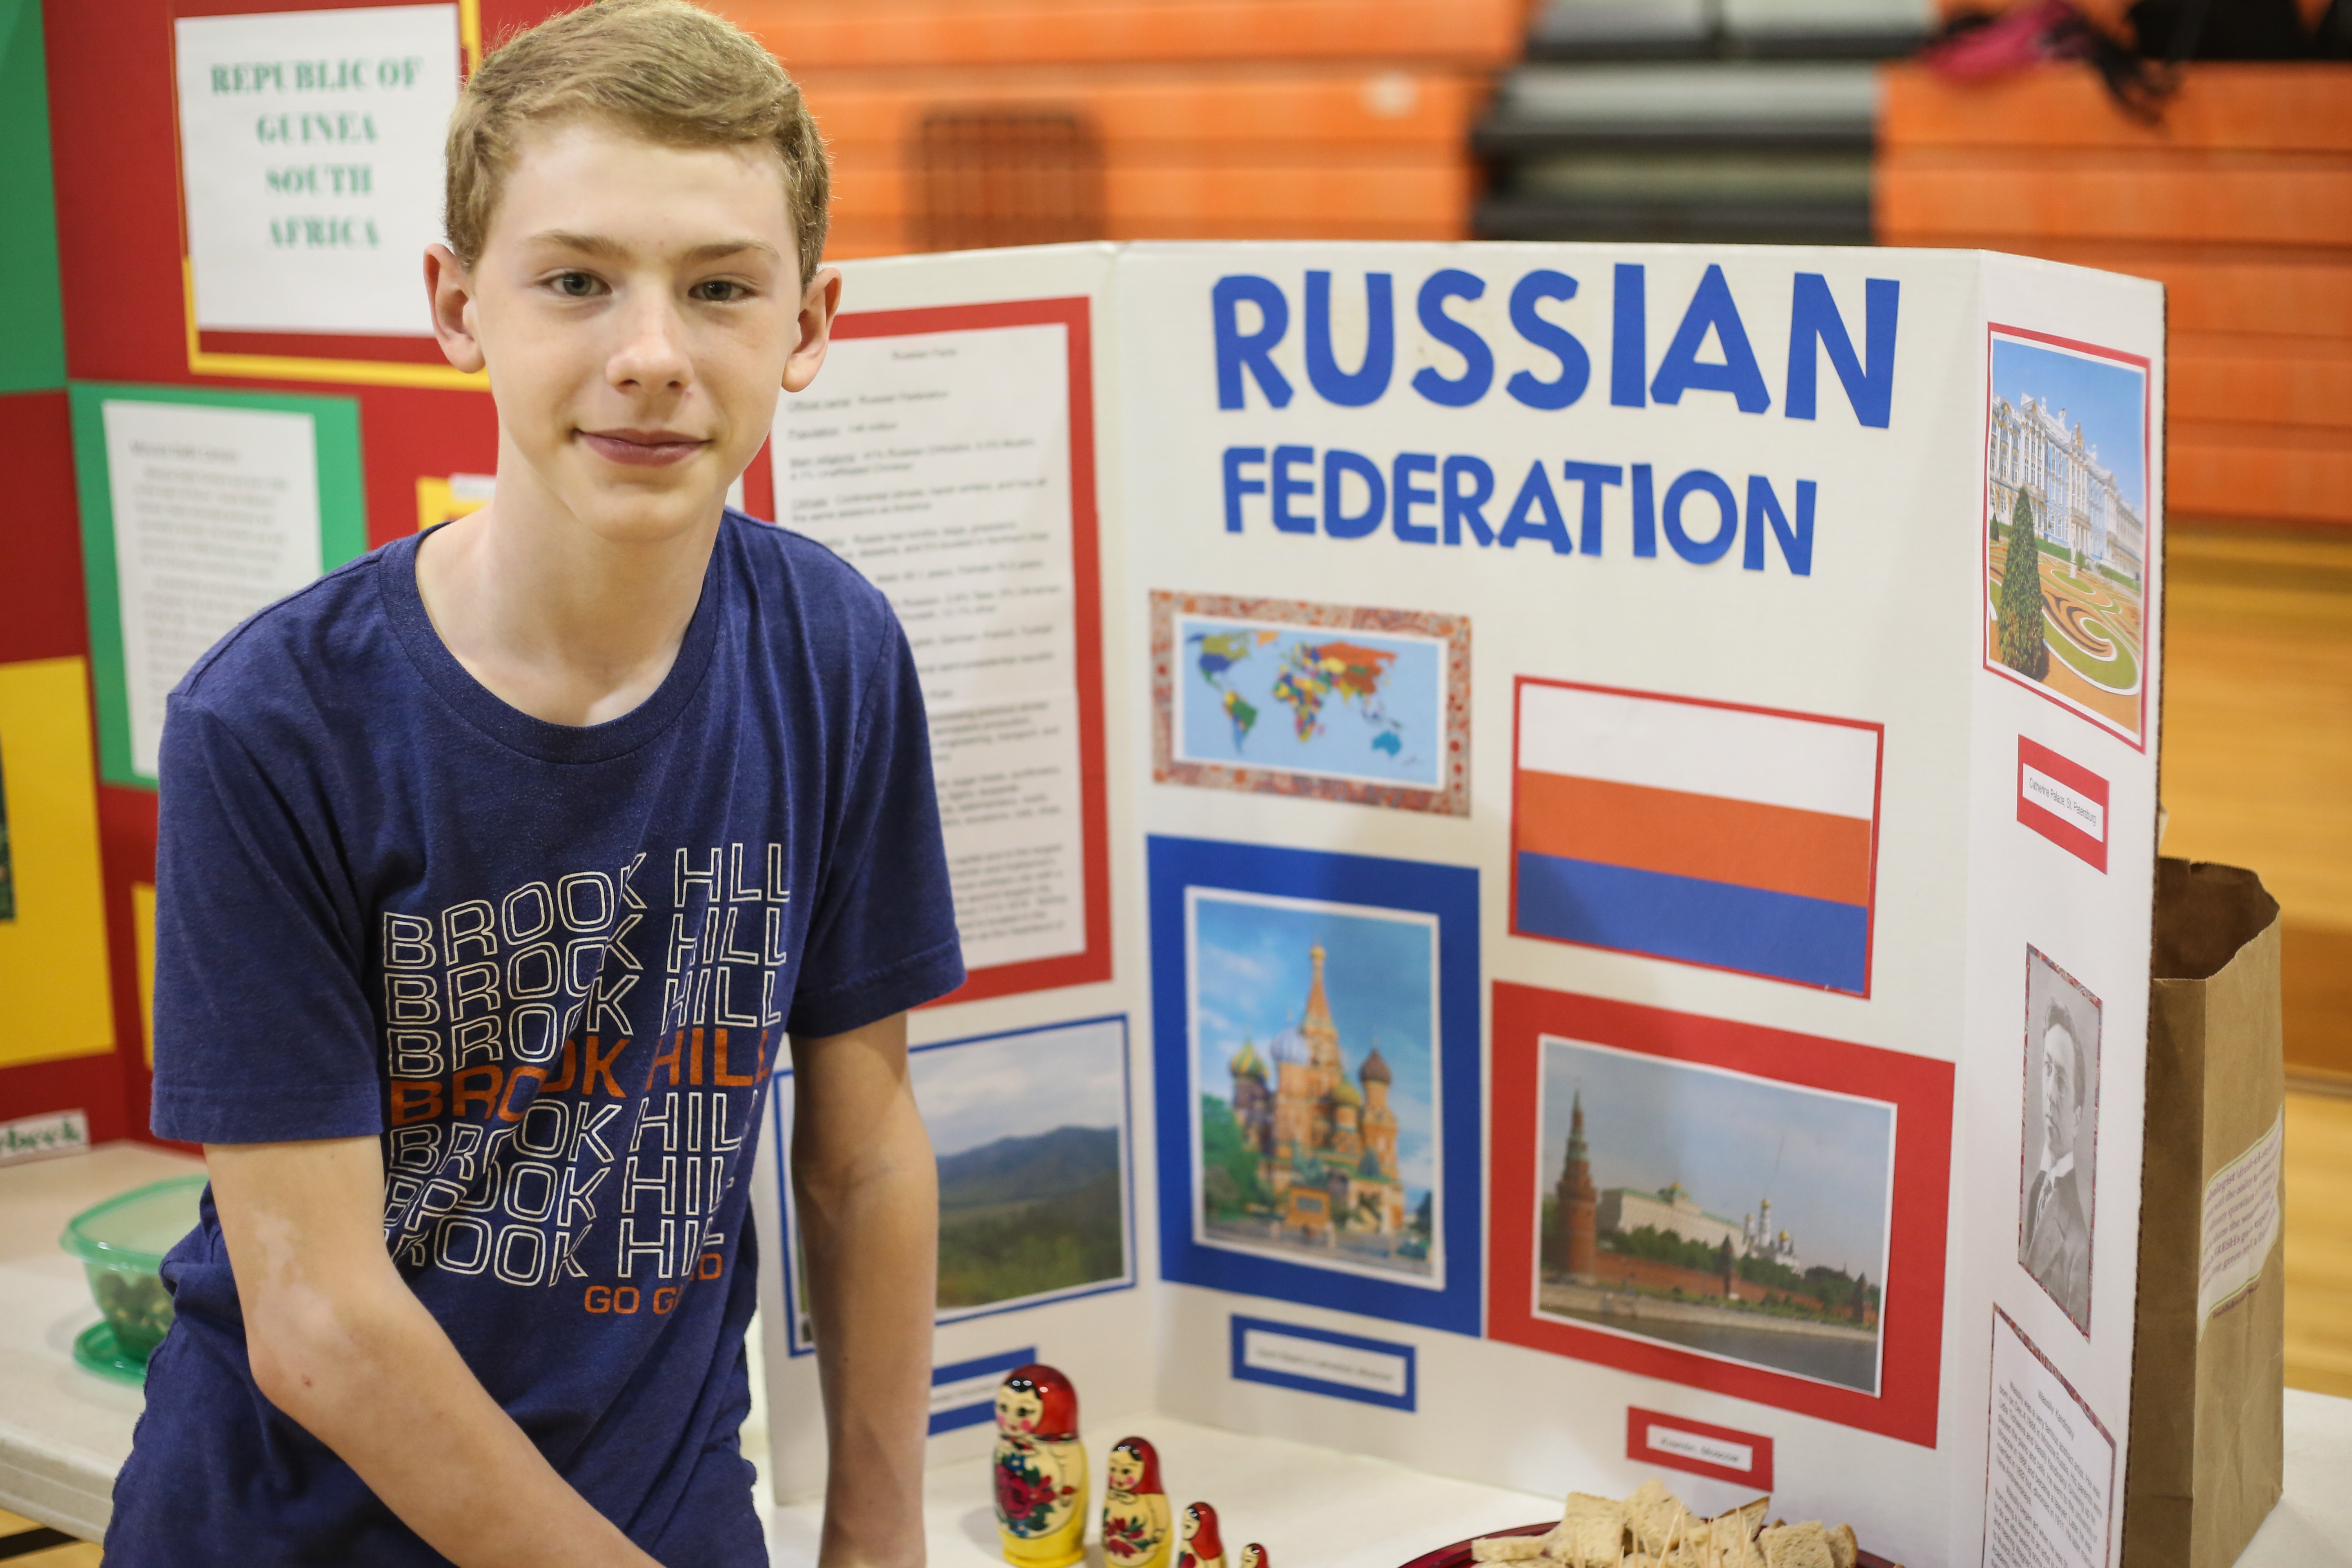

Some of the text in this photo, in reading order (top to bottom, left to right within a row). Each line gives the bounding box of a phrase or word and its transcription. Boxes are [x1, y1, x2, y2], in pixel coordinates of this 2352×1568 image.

[209, 55, 424, 95] REPUBLIC OF
[256, 112, 378, 146] GUINEA
[266, 163, 374, 196] SOUTH
[270, 216, 380, 247] AFRICA
[1211, 263, 1900, 429] RUSSIAN
[1223, 444, 1817, 577] FEDERATION
[2029, 777, 2049, 797] Catherine
[2074, 802, 2096, 826] Petersburg
[383, 852, 646, 969] BROOK
[385, 906, 787, 1026] BROOK HILL
[662, 967, 781, 1036] HILL
[390, 1028, 771, 1125] BROOK HILL
[629, 1089, 758, 1152] HIL
[621, 1156, 735, 1215] HIL
[384, 1216, 592, 1287] ROOK
[618, 1217, 724, 1278] HI
[585, 1285, 639, 1314] GO
[2036, 1414, 2045, 1430] very
[2045, 1423, 2058, 1446] famous
[2059, 1442, 2073, 1465] abstract
[2085, 1475, 2092, 1488] He
[2055, 1410, 2074, 1441] Kandinsky
[2033, 1487, 2049, 1512] divorced
[2066, 1528, 2071, 1541] He
[2035, 1474, 2050, 1498] became
[2069, 1517, 2078, 1535] Later
[2079, 1530, 2084, 1542] he
[2047, 1474, 2052, 1486] He
[2053, 1482, 2062, 1498] went
[2075, 1510, 2093, 1539] university
[2068, 1483, 2084, 1512] Growing
[2085, 1508, 2090, 1520] up
[2091, 1513, 2096, 1525] he
[2078, 1482, 2093, 1506] parents
[2094, 1503, 2102, 1518] were
[2039, 1528, 2048, 1545] when
[2049, 1541, 2054, 1553] he
